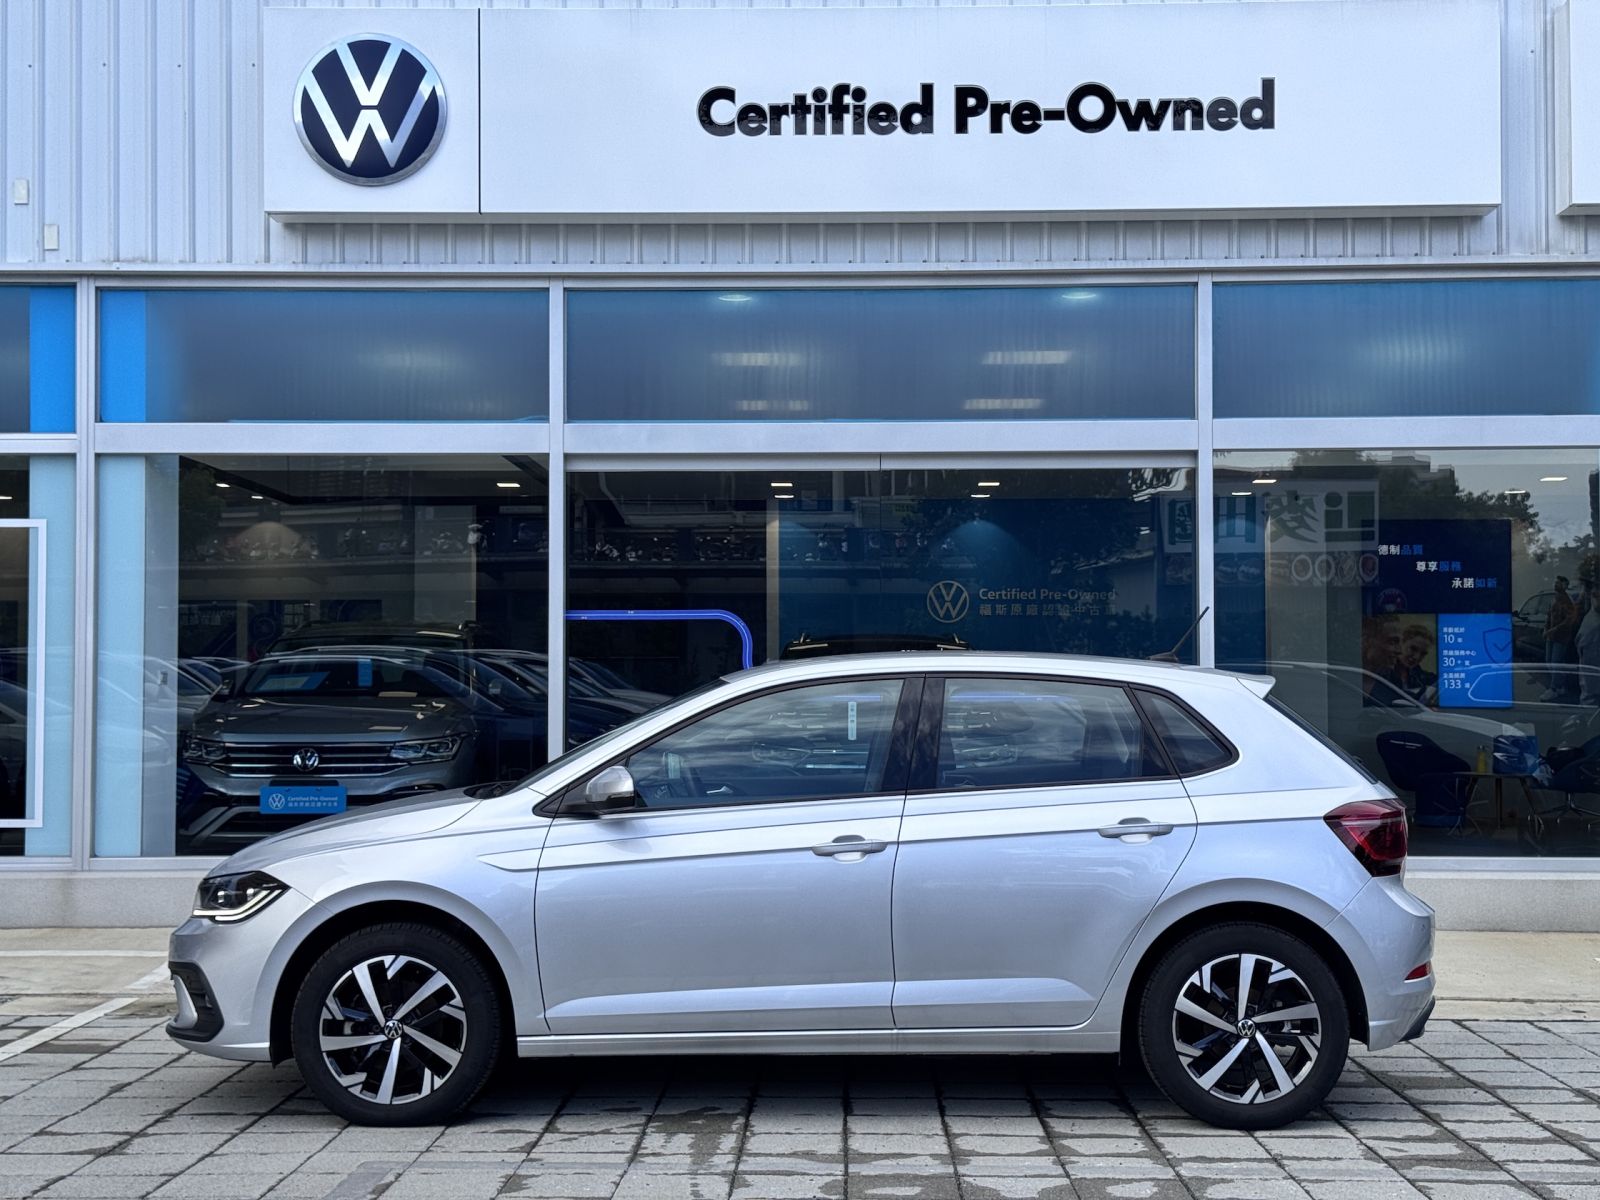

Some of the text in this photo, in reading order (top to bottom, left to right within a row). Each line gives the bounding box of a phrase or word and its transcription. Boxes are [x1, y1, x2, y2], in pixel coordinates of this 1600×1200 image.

[697, 77, 1277, 137] Certified Pre-Owned
[979, 587, 1116, 601] Certified Pre-Owned
[1444, 634, 1455, 644] 10
[1443, 679, 1462, 689] 133
